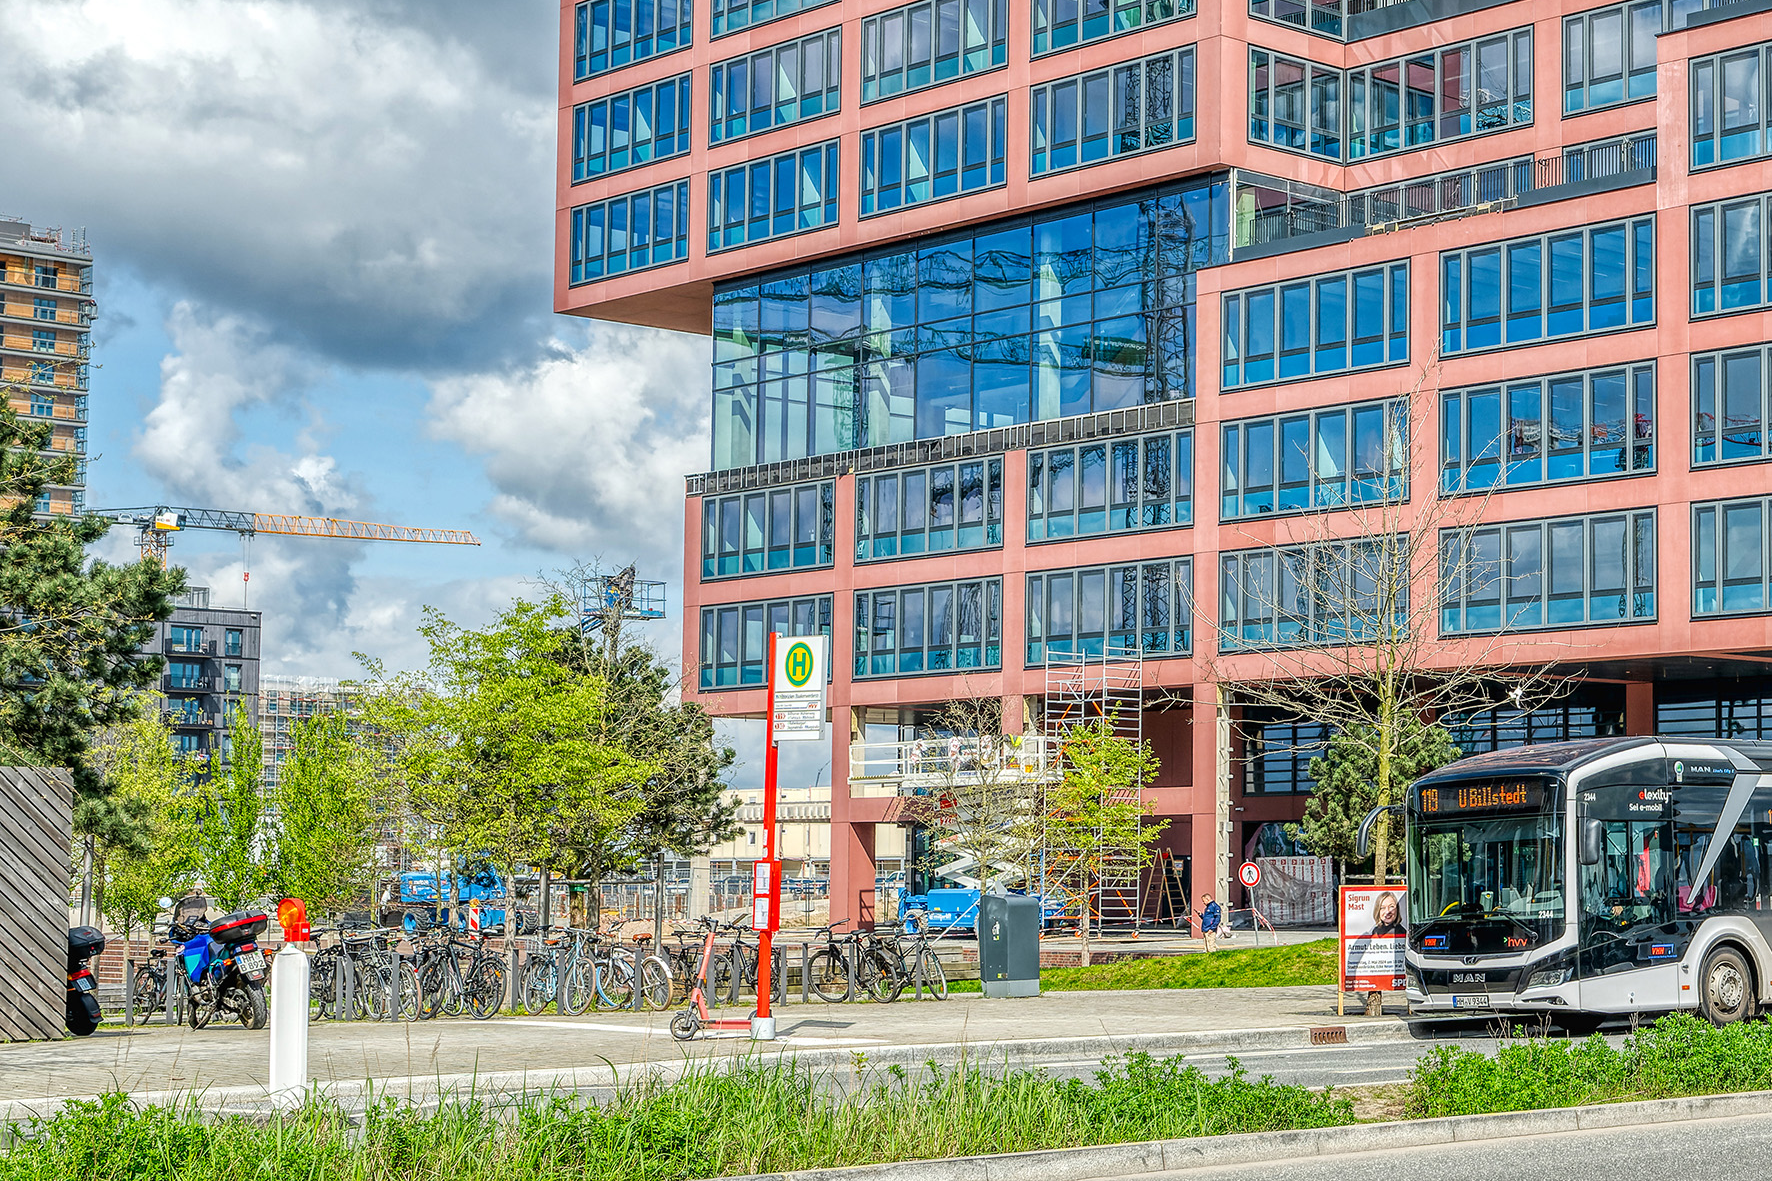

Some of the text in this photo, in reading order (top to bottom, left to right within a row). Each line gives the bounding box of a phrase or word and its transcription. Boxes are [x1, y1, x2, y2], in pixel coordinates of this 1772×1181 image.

[793, 652, 806, 676] H
[1421, 784, 1527, 813] 119 U Billstedt
[1583, 793, 1596, 802] 2344
[1638, 789, 1670, 803] elexity
[1629, 803, 1663, 812] Sei e-mobil
[1348, 894, 1370, 903] Sigrun
[1348, 903, 1364, 911] Mast
[1538, 910, 1553, 919] 2344
[1507, 936, 1528, 947] hvv
[242, 954, 255, 963] HH
[240, 959, 266, 972] B 892
[1452, 973, 1486, 983] MAN
[1472, 997, 1487, 1005] 9344
